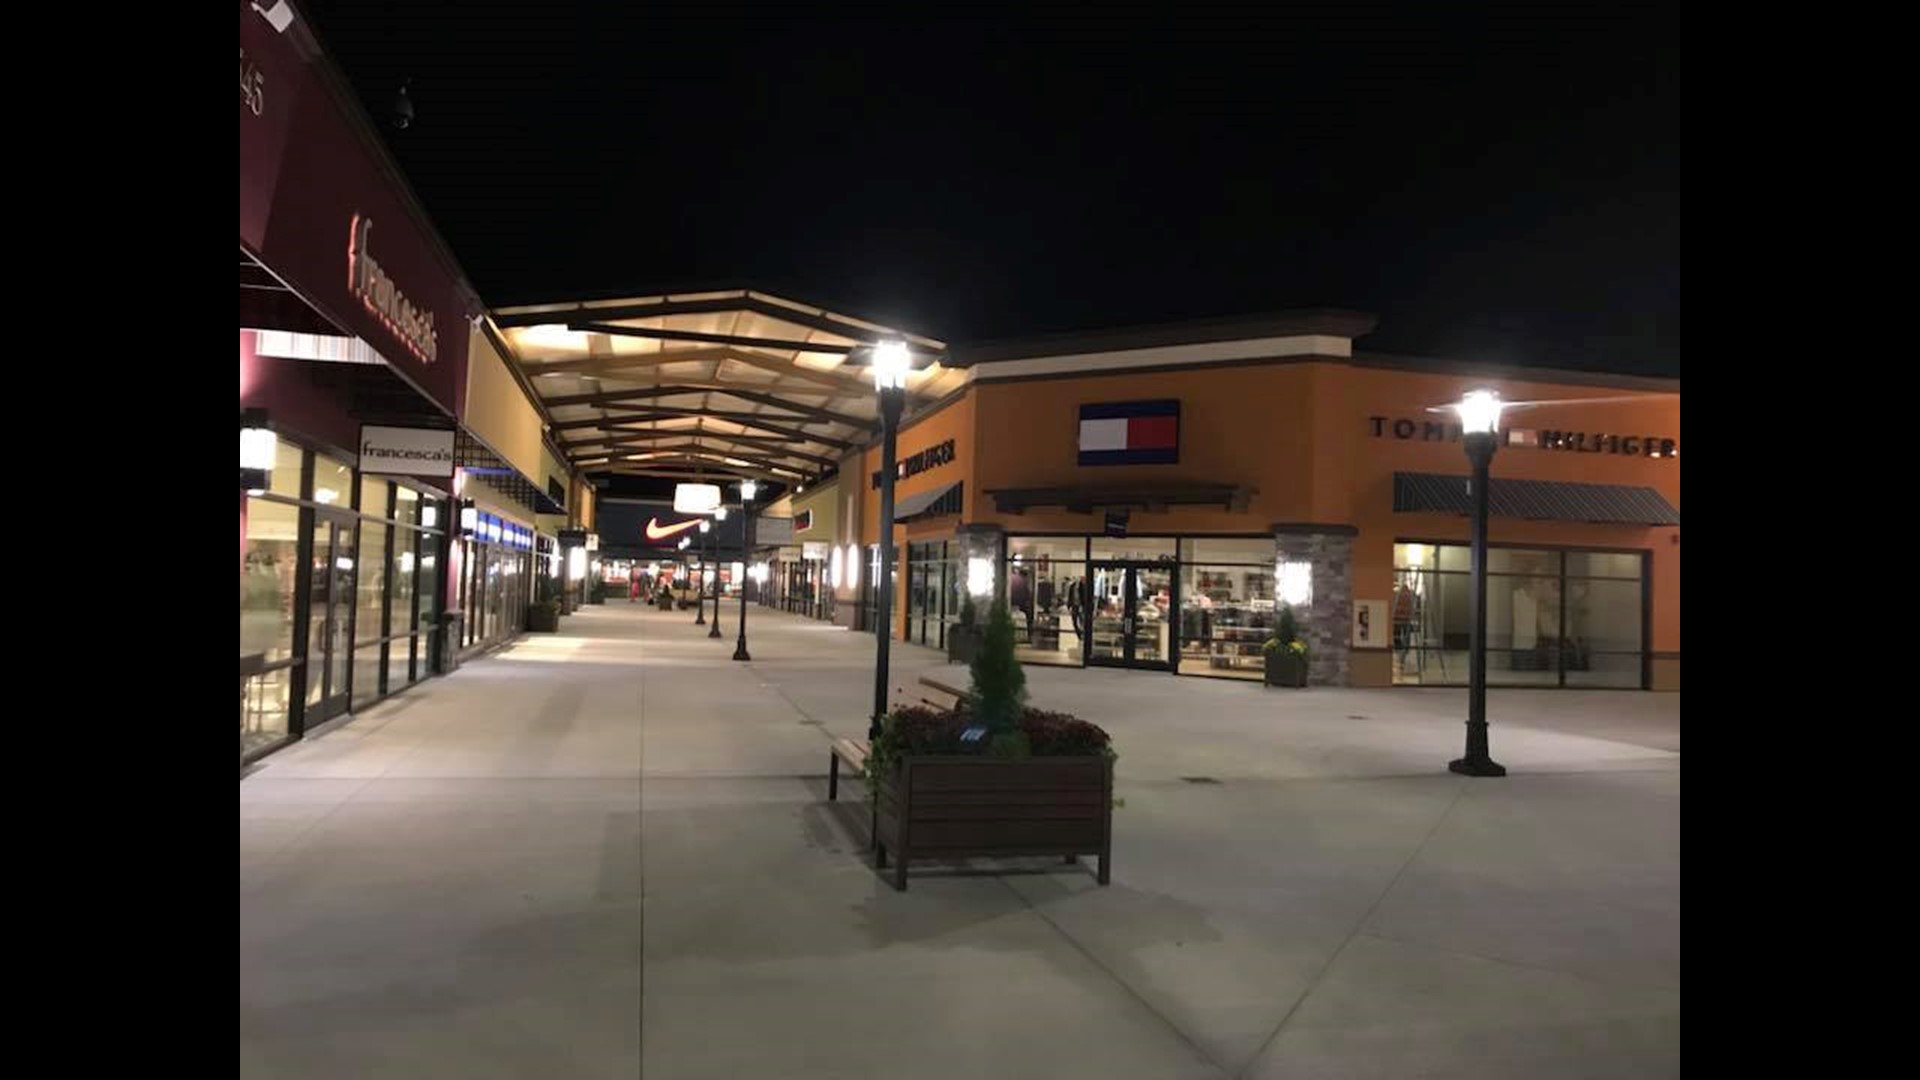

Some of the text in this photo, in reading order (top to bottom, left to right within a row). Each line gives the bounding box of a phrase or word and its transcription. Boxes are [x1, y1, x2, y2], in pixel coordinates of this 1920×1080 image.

[349, 212, 438, 364] francesca's
[363, 439, 452, 461] francesca's
[1541, 430, 1676, 458] HILFIGER
